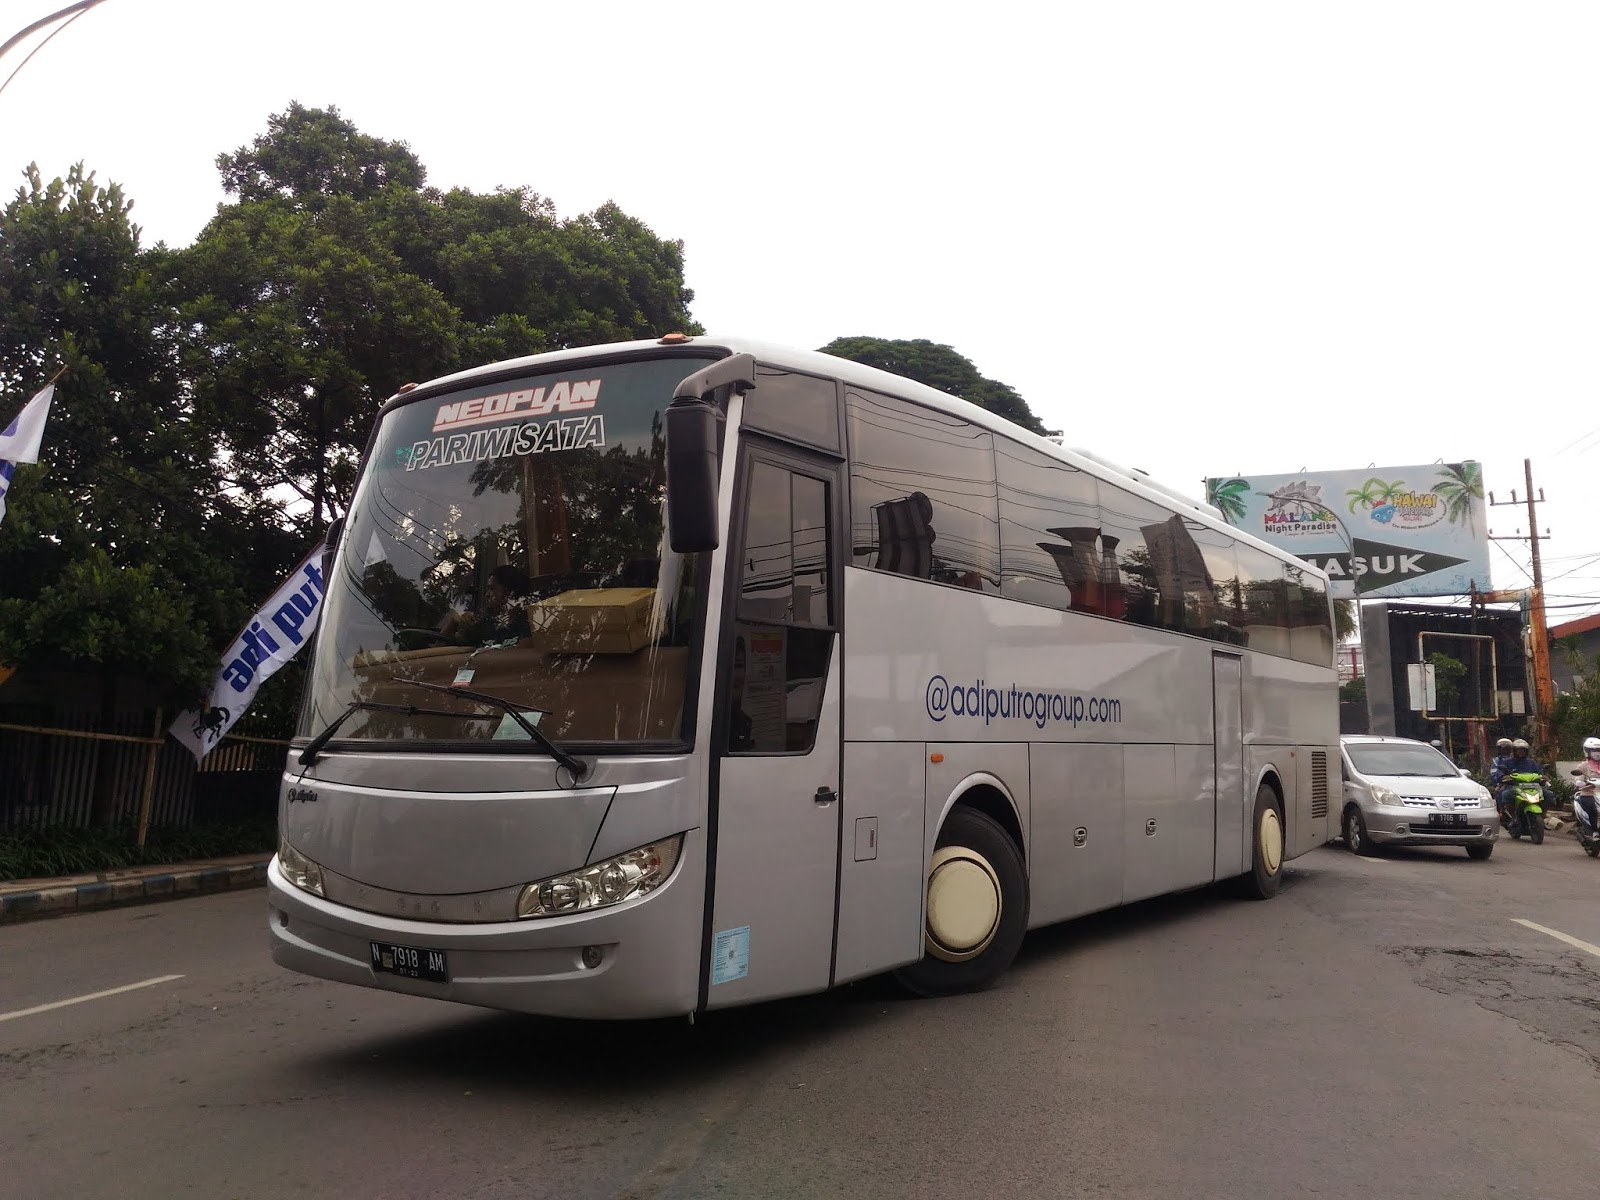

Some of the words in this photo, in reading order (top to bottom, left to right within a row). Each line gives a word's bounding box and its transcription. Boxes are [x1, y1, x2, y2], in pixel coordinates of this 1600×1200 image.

[433, 379, 601, 431] NEOPLAN
[406, 415, 606, 472] PARIWISATA
[1264, 510, 1336, 524] MALANG
[1393, 490, 1438, 508] HAWAI
[1265, 524, 1292, 533] Night
[1295, 522, 1337, 531] Paradise
[222, 621, 280, 693] adi
[926, 675, 1122, 729] @adiputrogroup.com
[372, 943, 380, 961] N
[391, 946, 418, 968] 7918
[429, 952, 444, 972] AM
